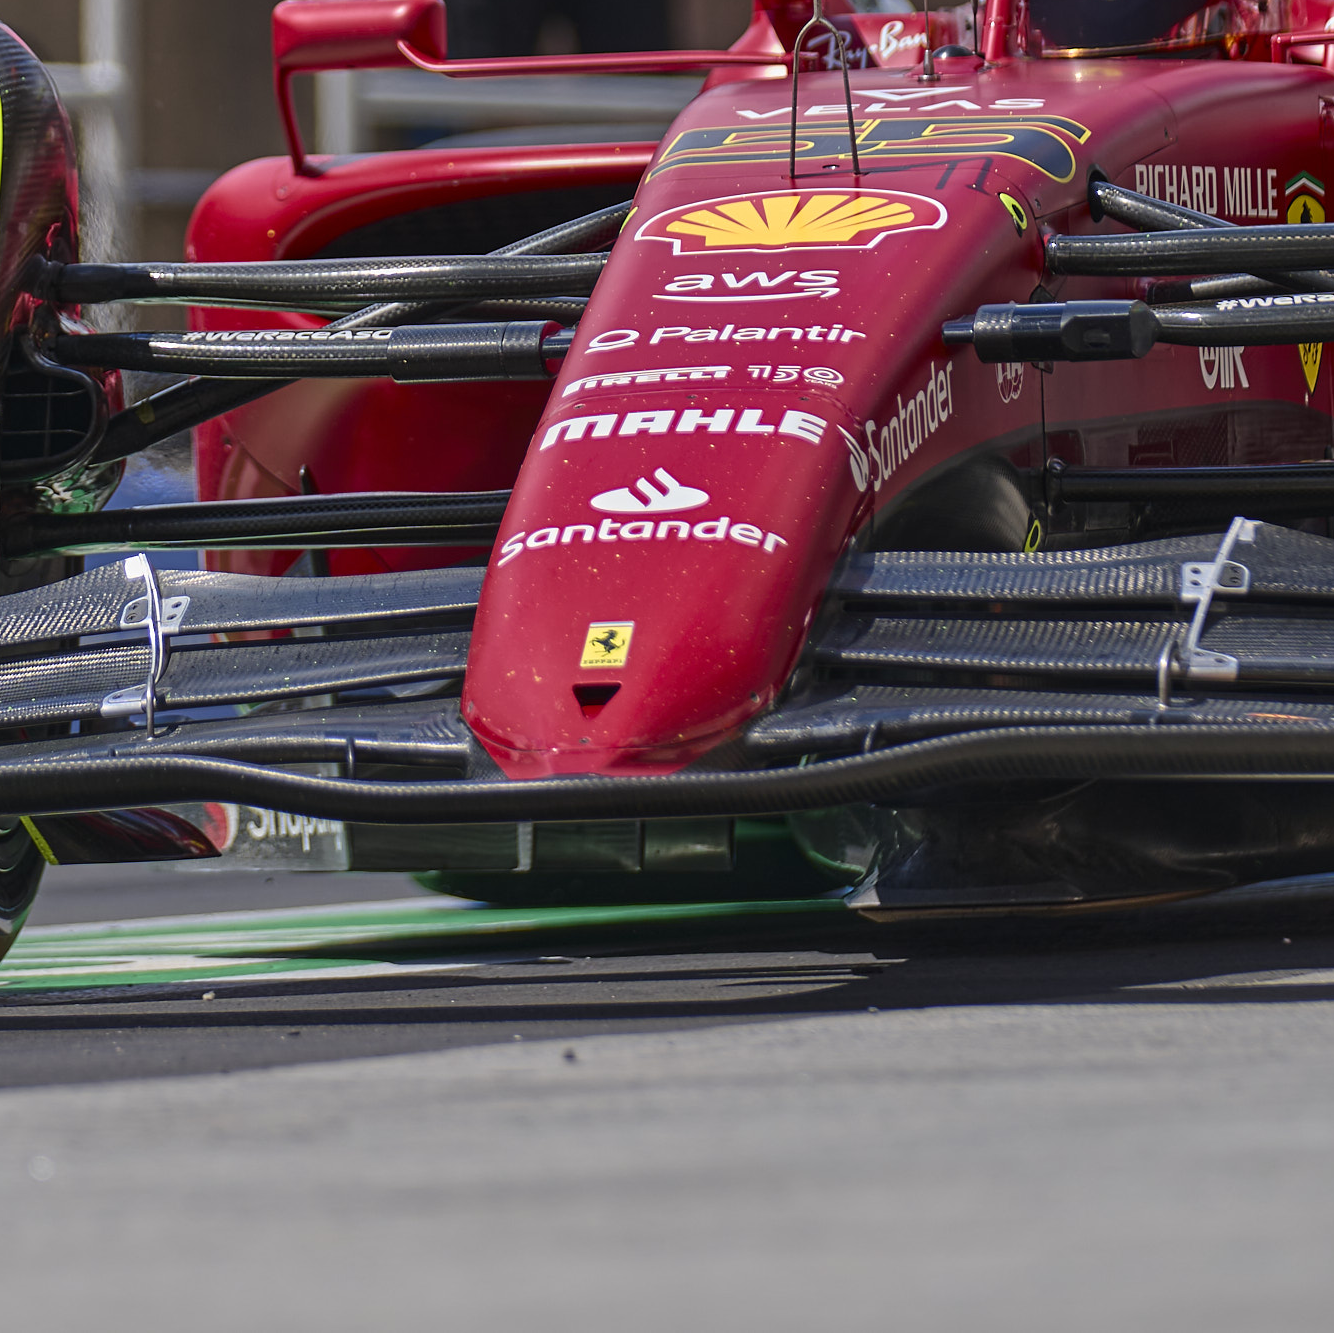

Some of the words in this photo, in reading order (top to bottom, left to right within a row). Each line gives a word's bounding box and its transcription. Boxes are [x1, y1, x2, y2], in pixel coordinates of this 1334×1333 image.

[735, 98, 1046, 119] VELAS
[644, 114, 1092, 184] 55
[1135, 163, 1217, 215] RICHARD
[1223, 166, 1278, 218] MILLE
[665, 269, 840, 292] aws
[182, 328, 393, 342] #WeRaceAsO
[649, 323, 867, 346] Palantir
[562, 364, 732, 398] PIRELLI
[539, 408, 828, 452] MAHLE
[865, 359, 953, 493] Santander
[497, 516, 789, 567] Santander
